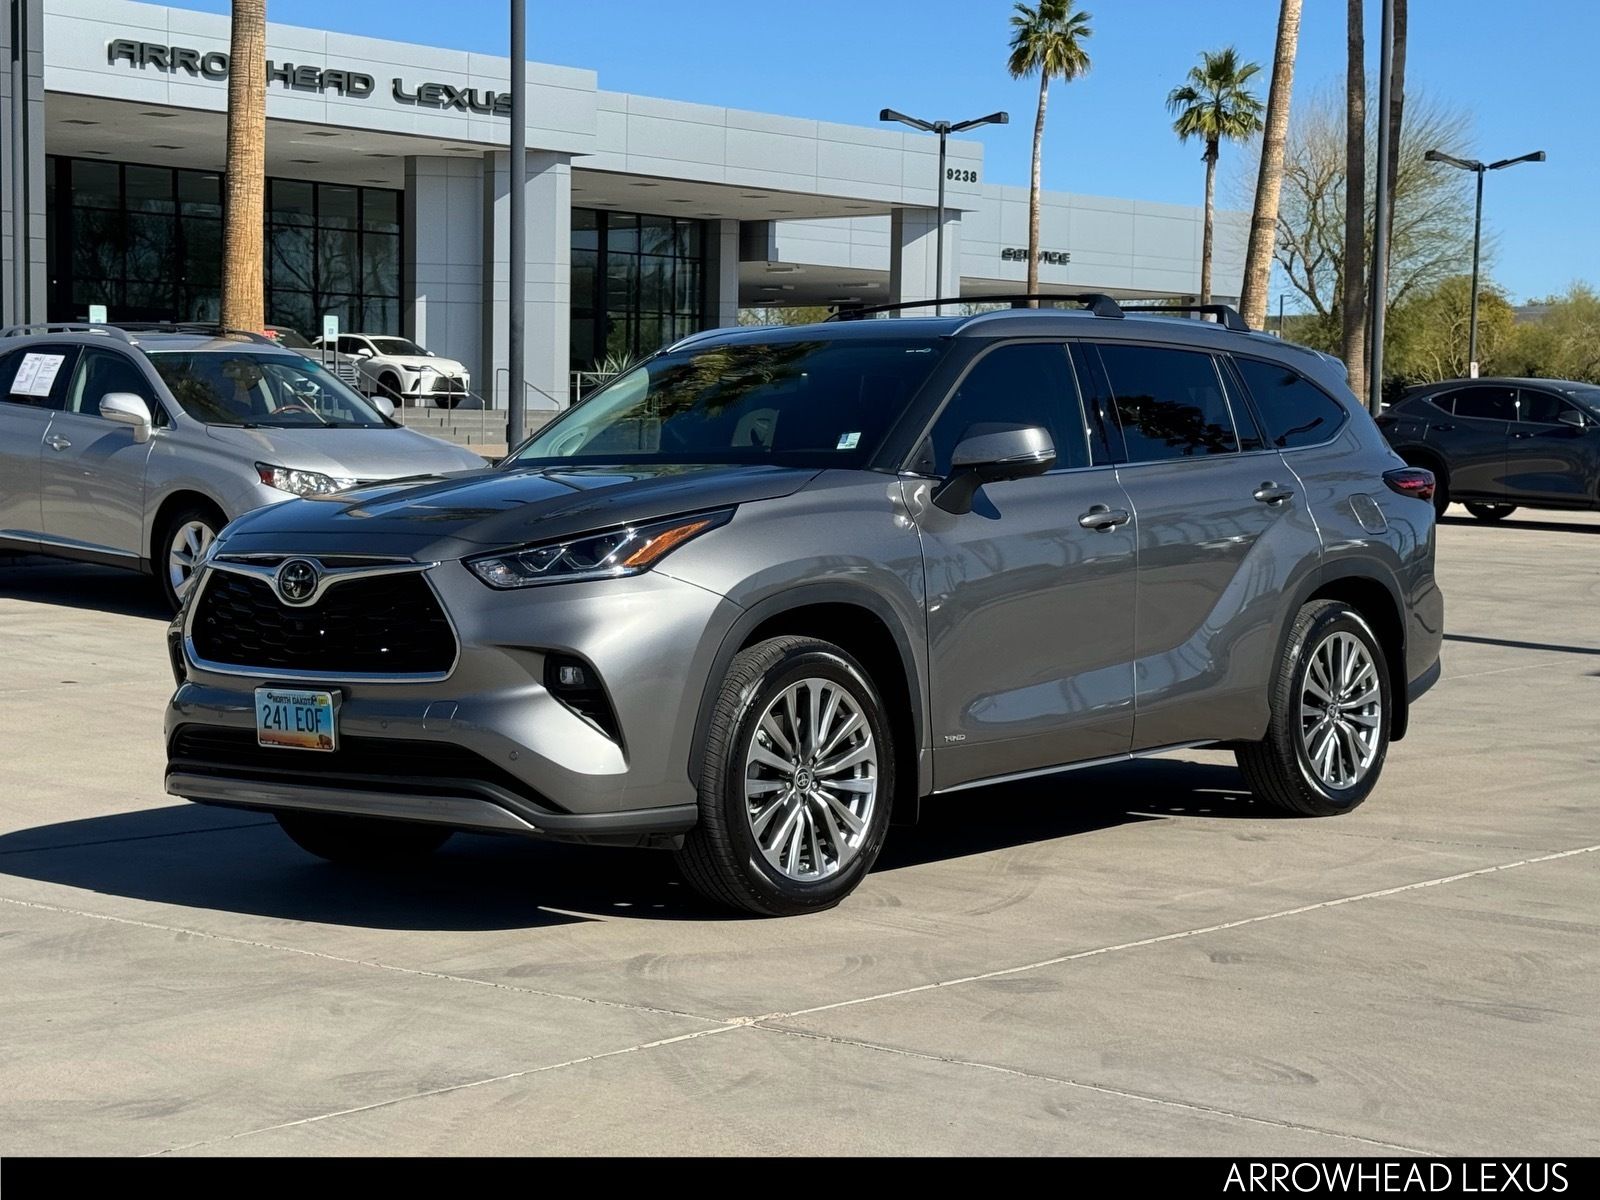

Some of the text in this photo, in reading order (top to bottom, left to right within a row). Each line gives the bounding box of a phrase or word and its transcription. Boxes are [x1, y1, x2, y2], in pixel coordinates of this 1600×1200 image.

[108, 39, 512, 116] ARROHEAD LEXUS
[946, 168, 978, 183] 9238
[263, 704, 323, 733] 241 EOF
